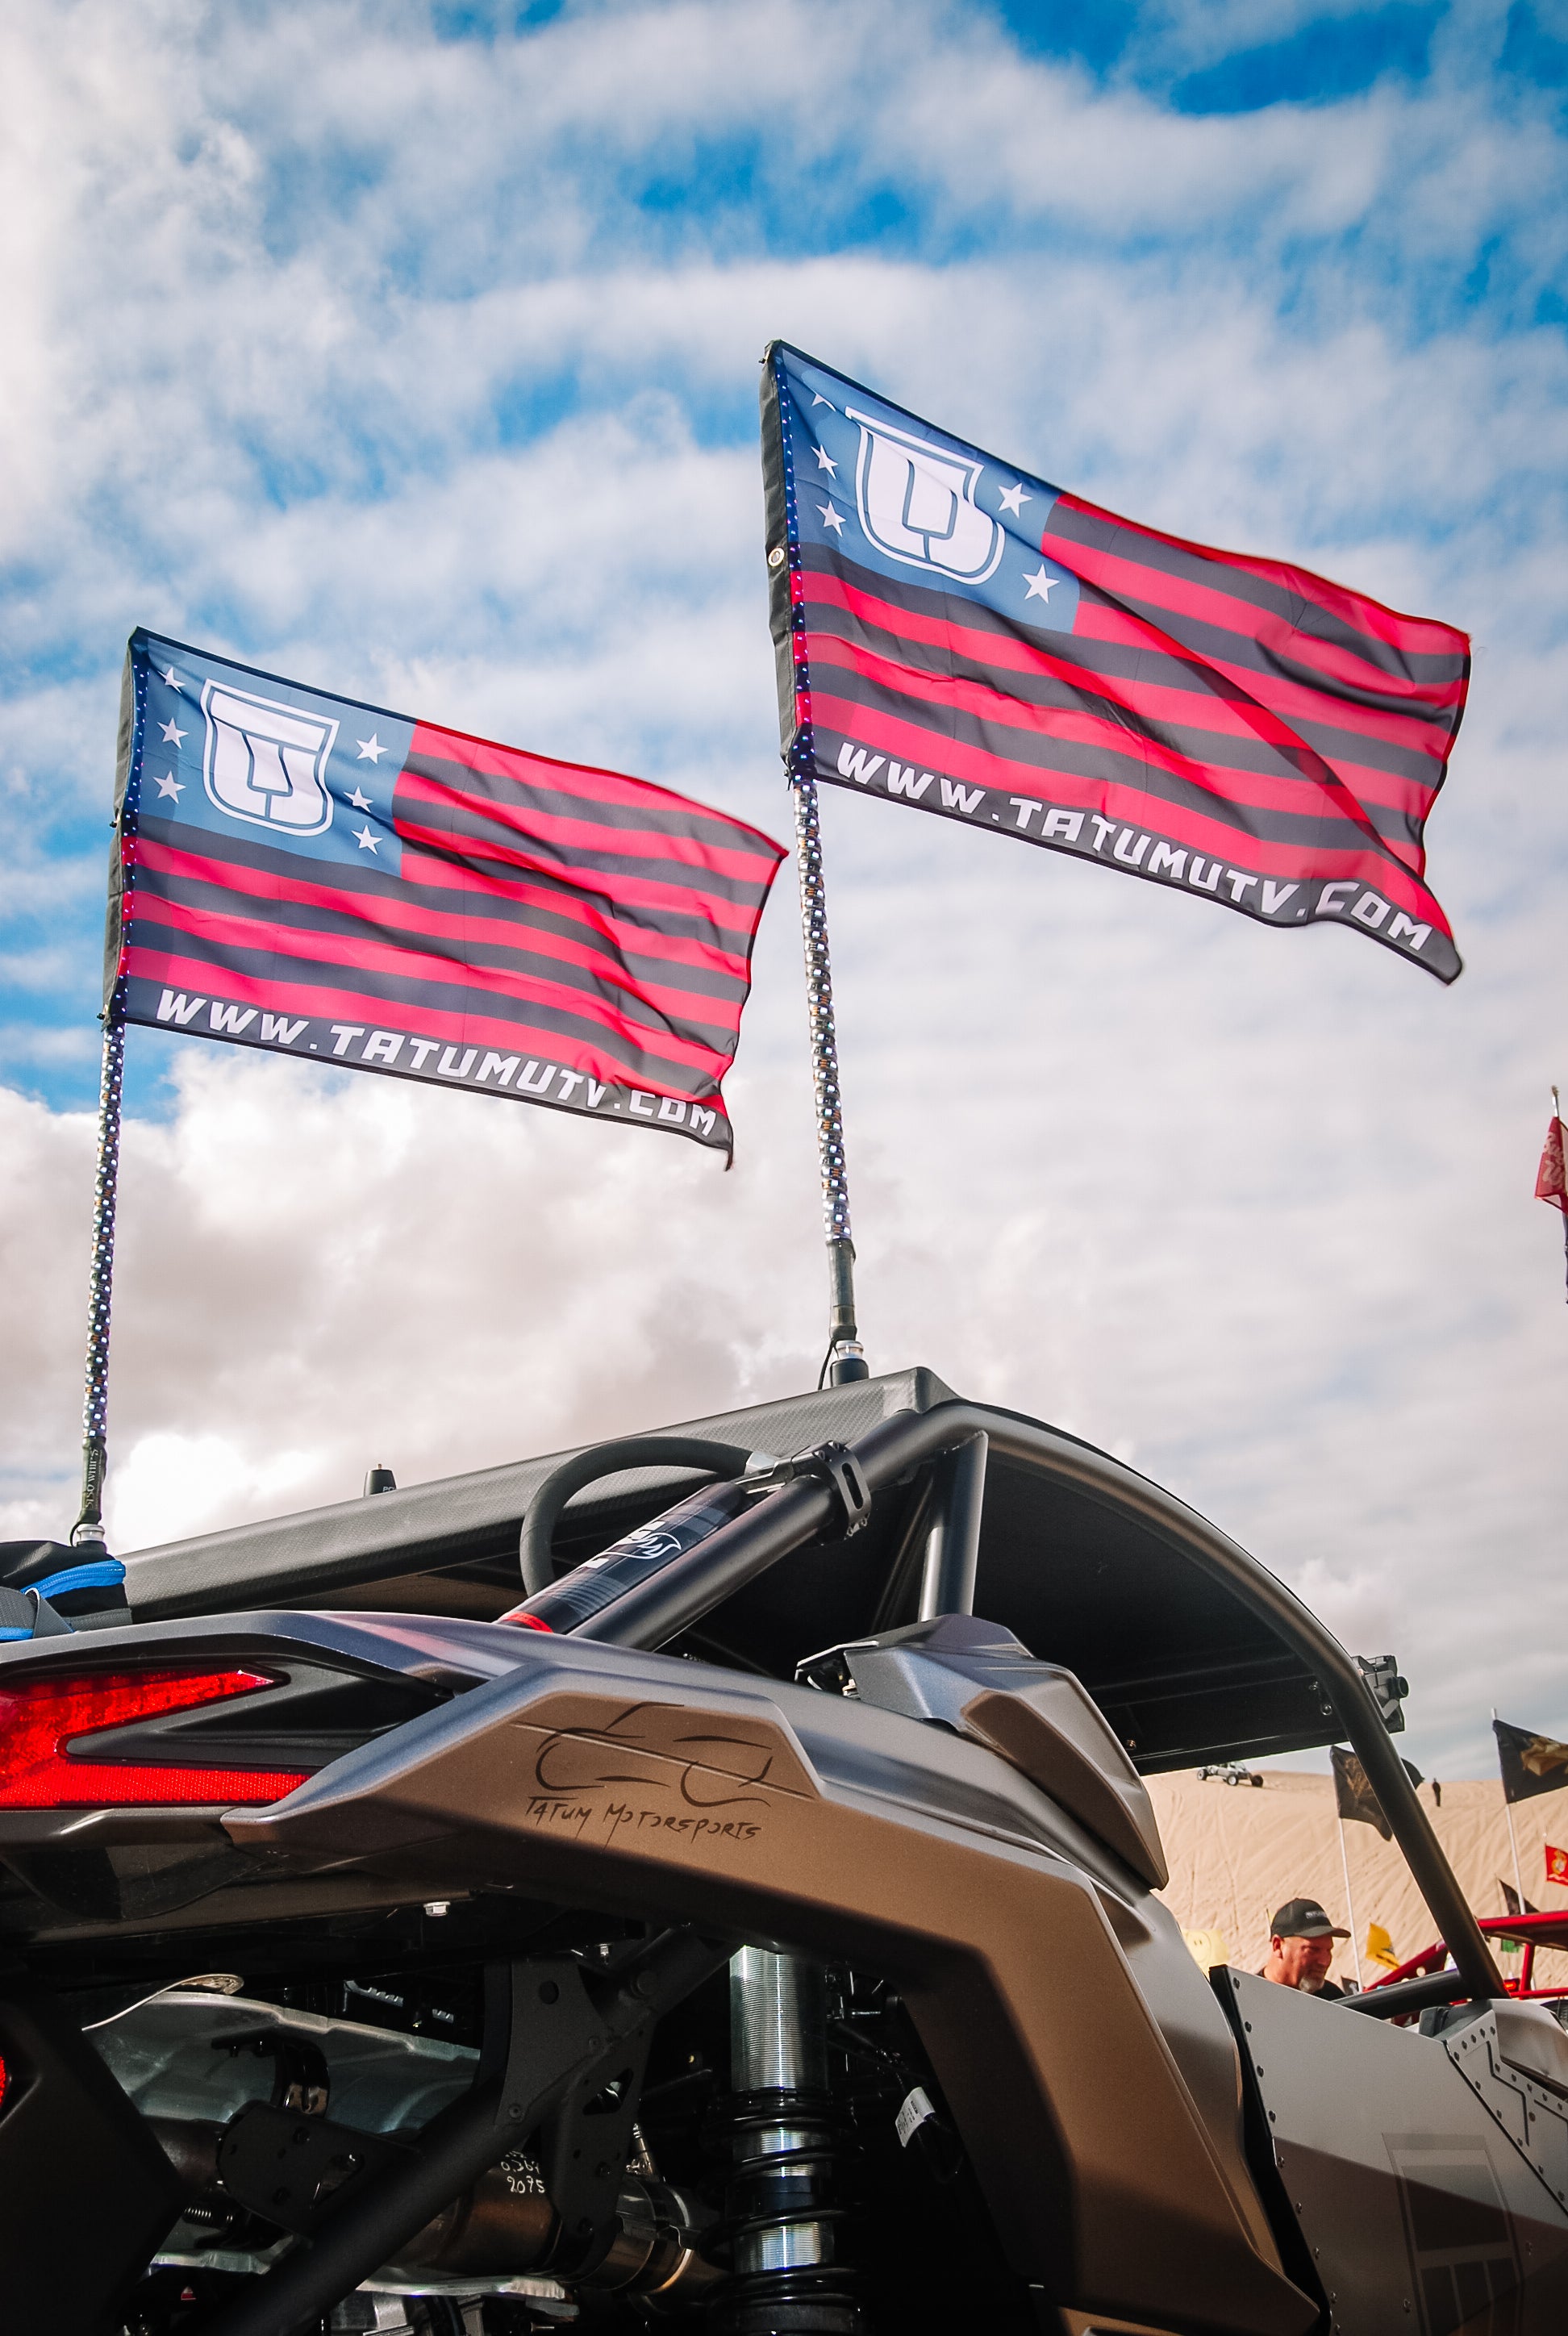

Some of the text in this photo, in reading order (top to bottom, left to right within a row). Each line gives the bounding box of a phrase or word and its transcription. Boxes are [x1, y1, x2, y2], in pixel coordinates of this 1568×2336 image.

[836, 743, 1433, 951] WWW.TATUMUTV.COM
[156, 989, 718, 1137] WWW.TATUMUTV.COM
[526, 1796, 762, 1851] TATUM MOTORSPORTS
